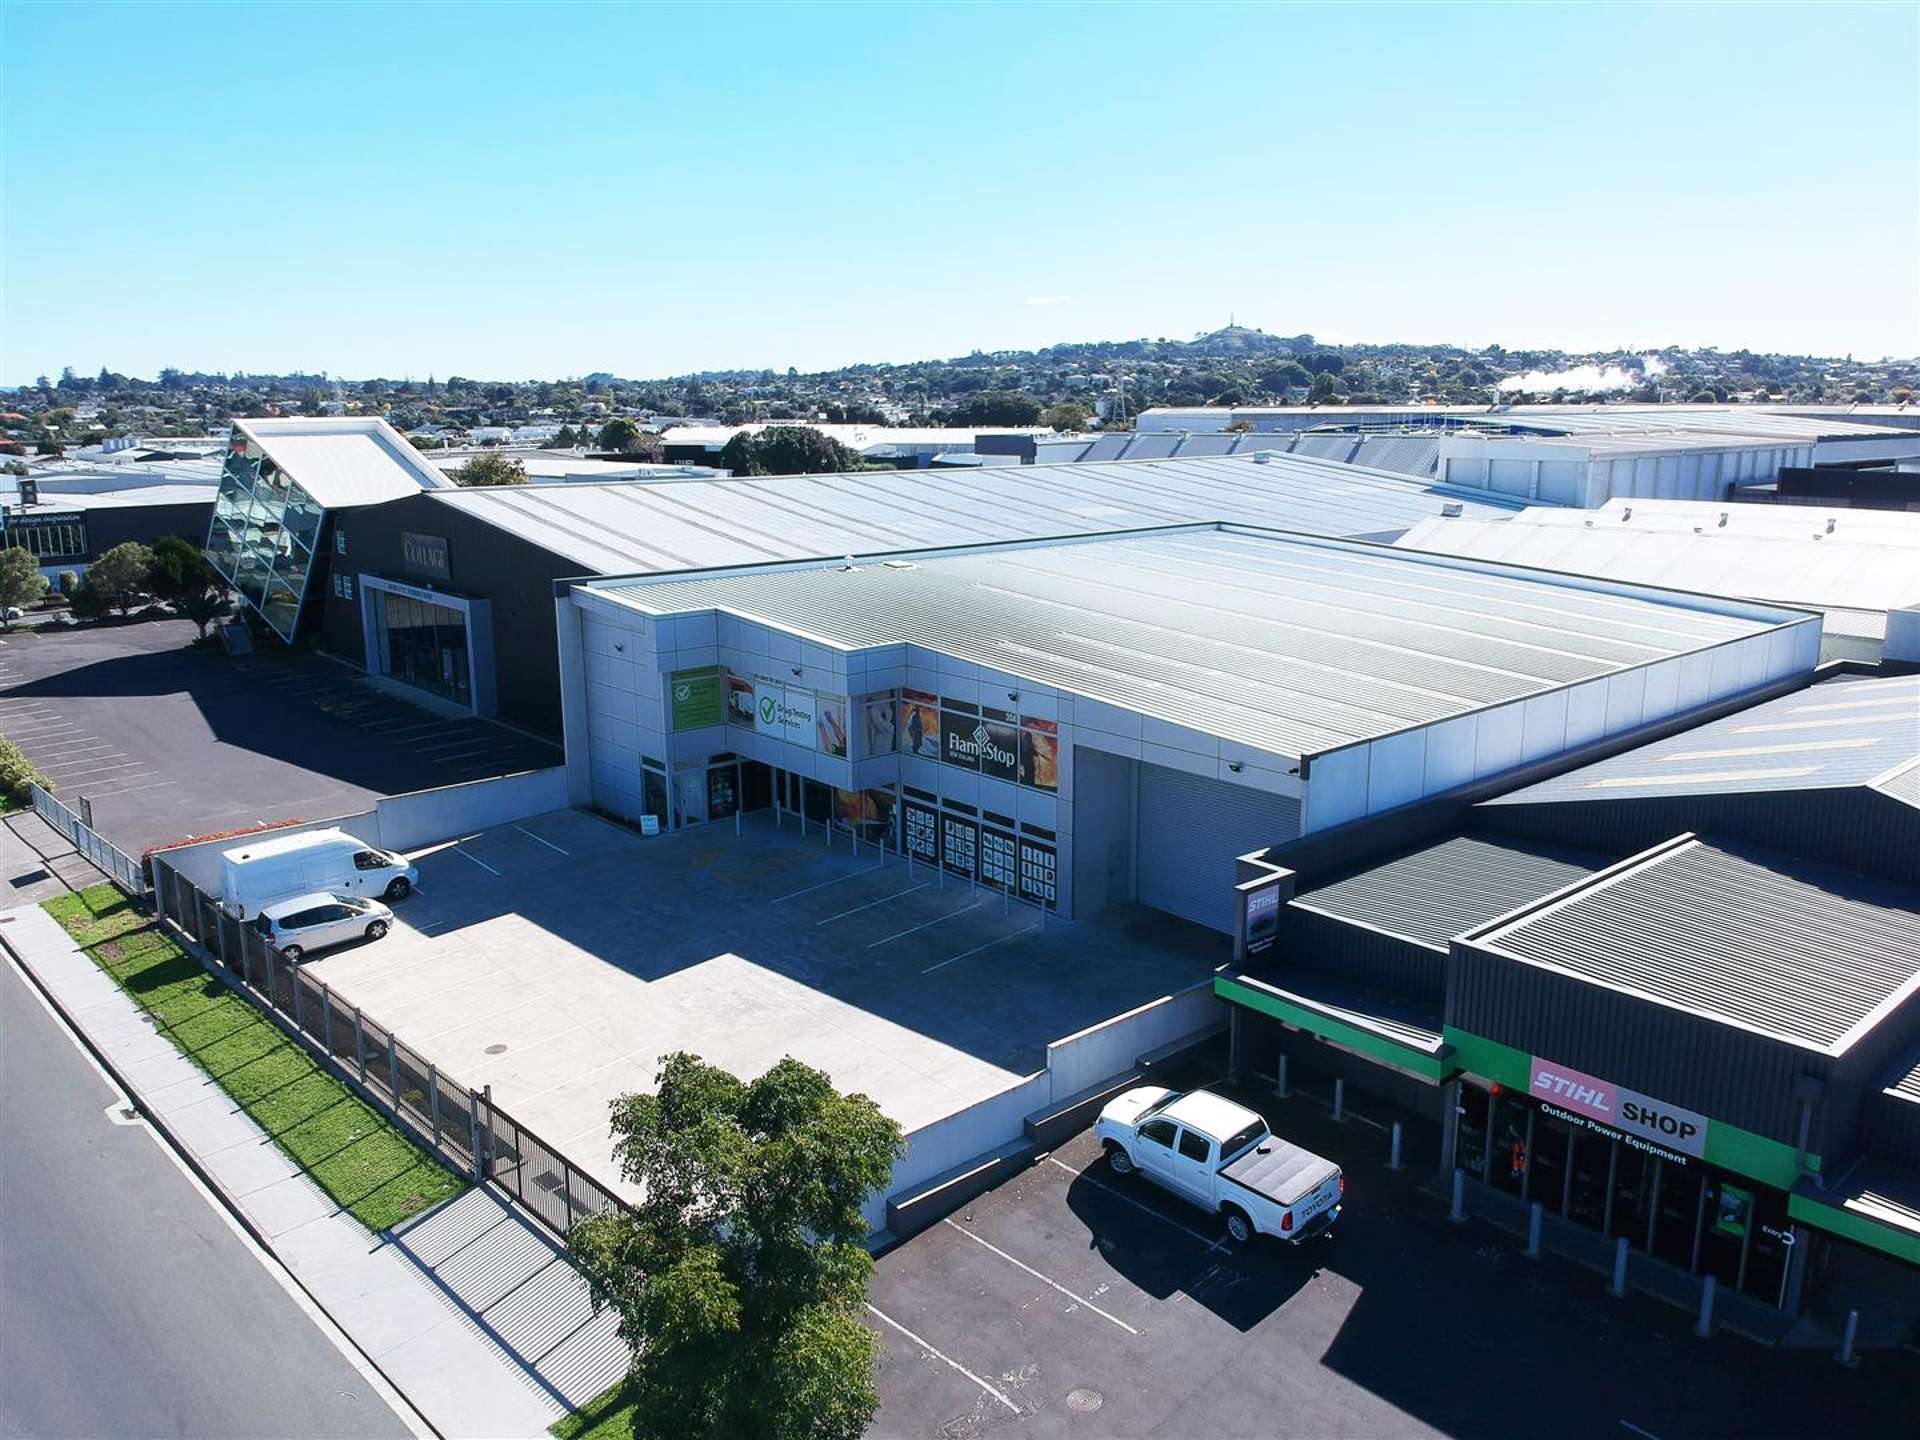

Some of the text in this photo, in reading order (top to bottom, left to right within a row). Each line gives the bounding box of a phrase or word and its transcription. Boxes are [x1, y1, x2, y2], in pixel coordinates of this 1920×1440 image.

[1248, 893, 1278, 913] STIHL
[1534, 1070, 1697, 1140] STIHL SHOP
[1540, 1102, 1688, 1166] Outdoor Power Equipment
[1301, 1192, 1333, 1217] TOYOTA
